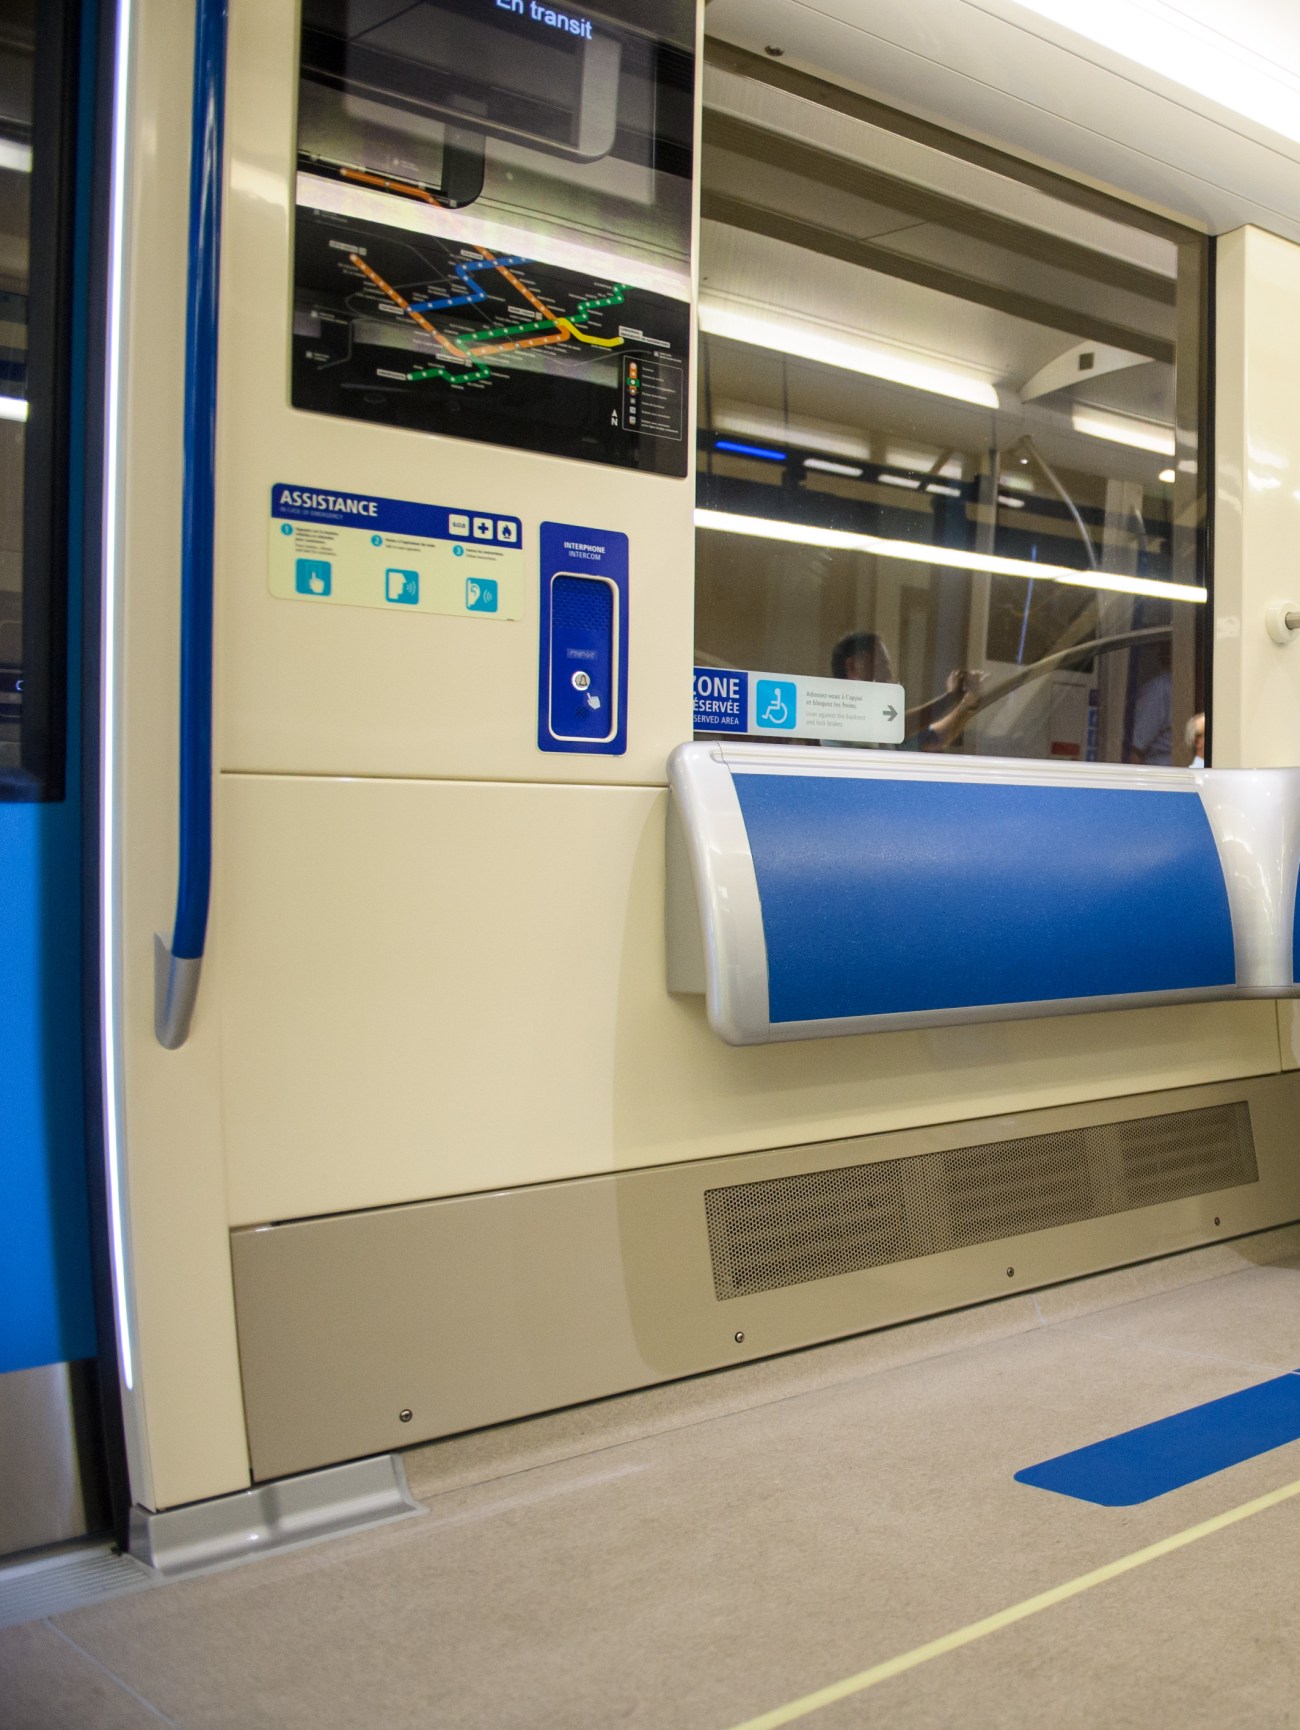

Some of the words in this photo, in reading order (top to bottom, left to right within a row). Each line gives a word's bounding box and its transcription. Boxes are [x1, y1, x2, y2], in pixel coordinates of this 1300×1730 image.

[530, 1, 592, 39] transit
[280, 490, 378, 517] ASSISTANCE
[563, 541, 606, 554] INTERPHONE
[568, 550, 601, 561] INTERCOM
[721, 716, 740, 725] AREA
